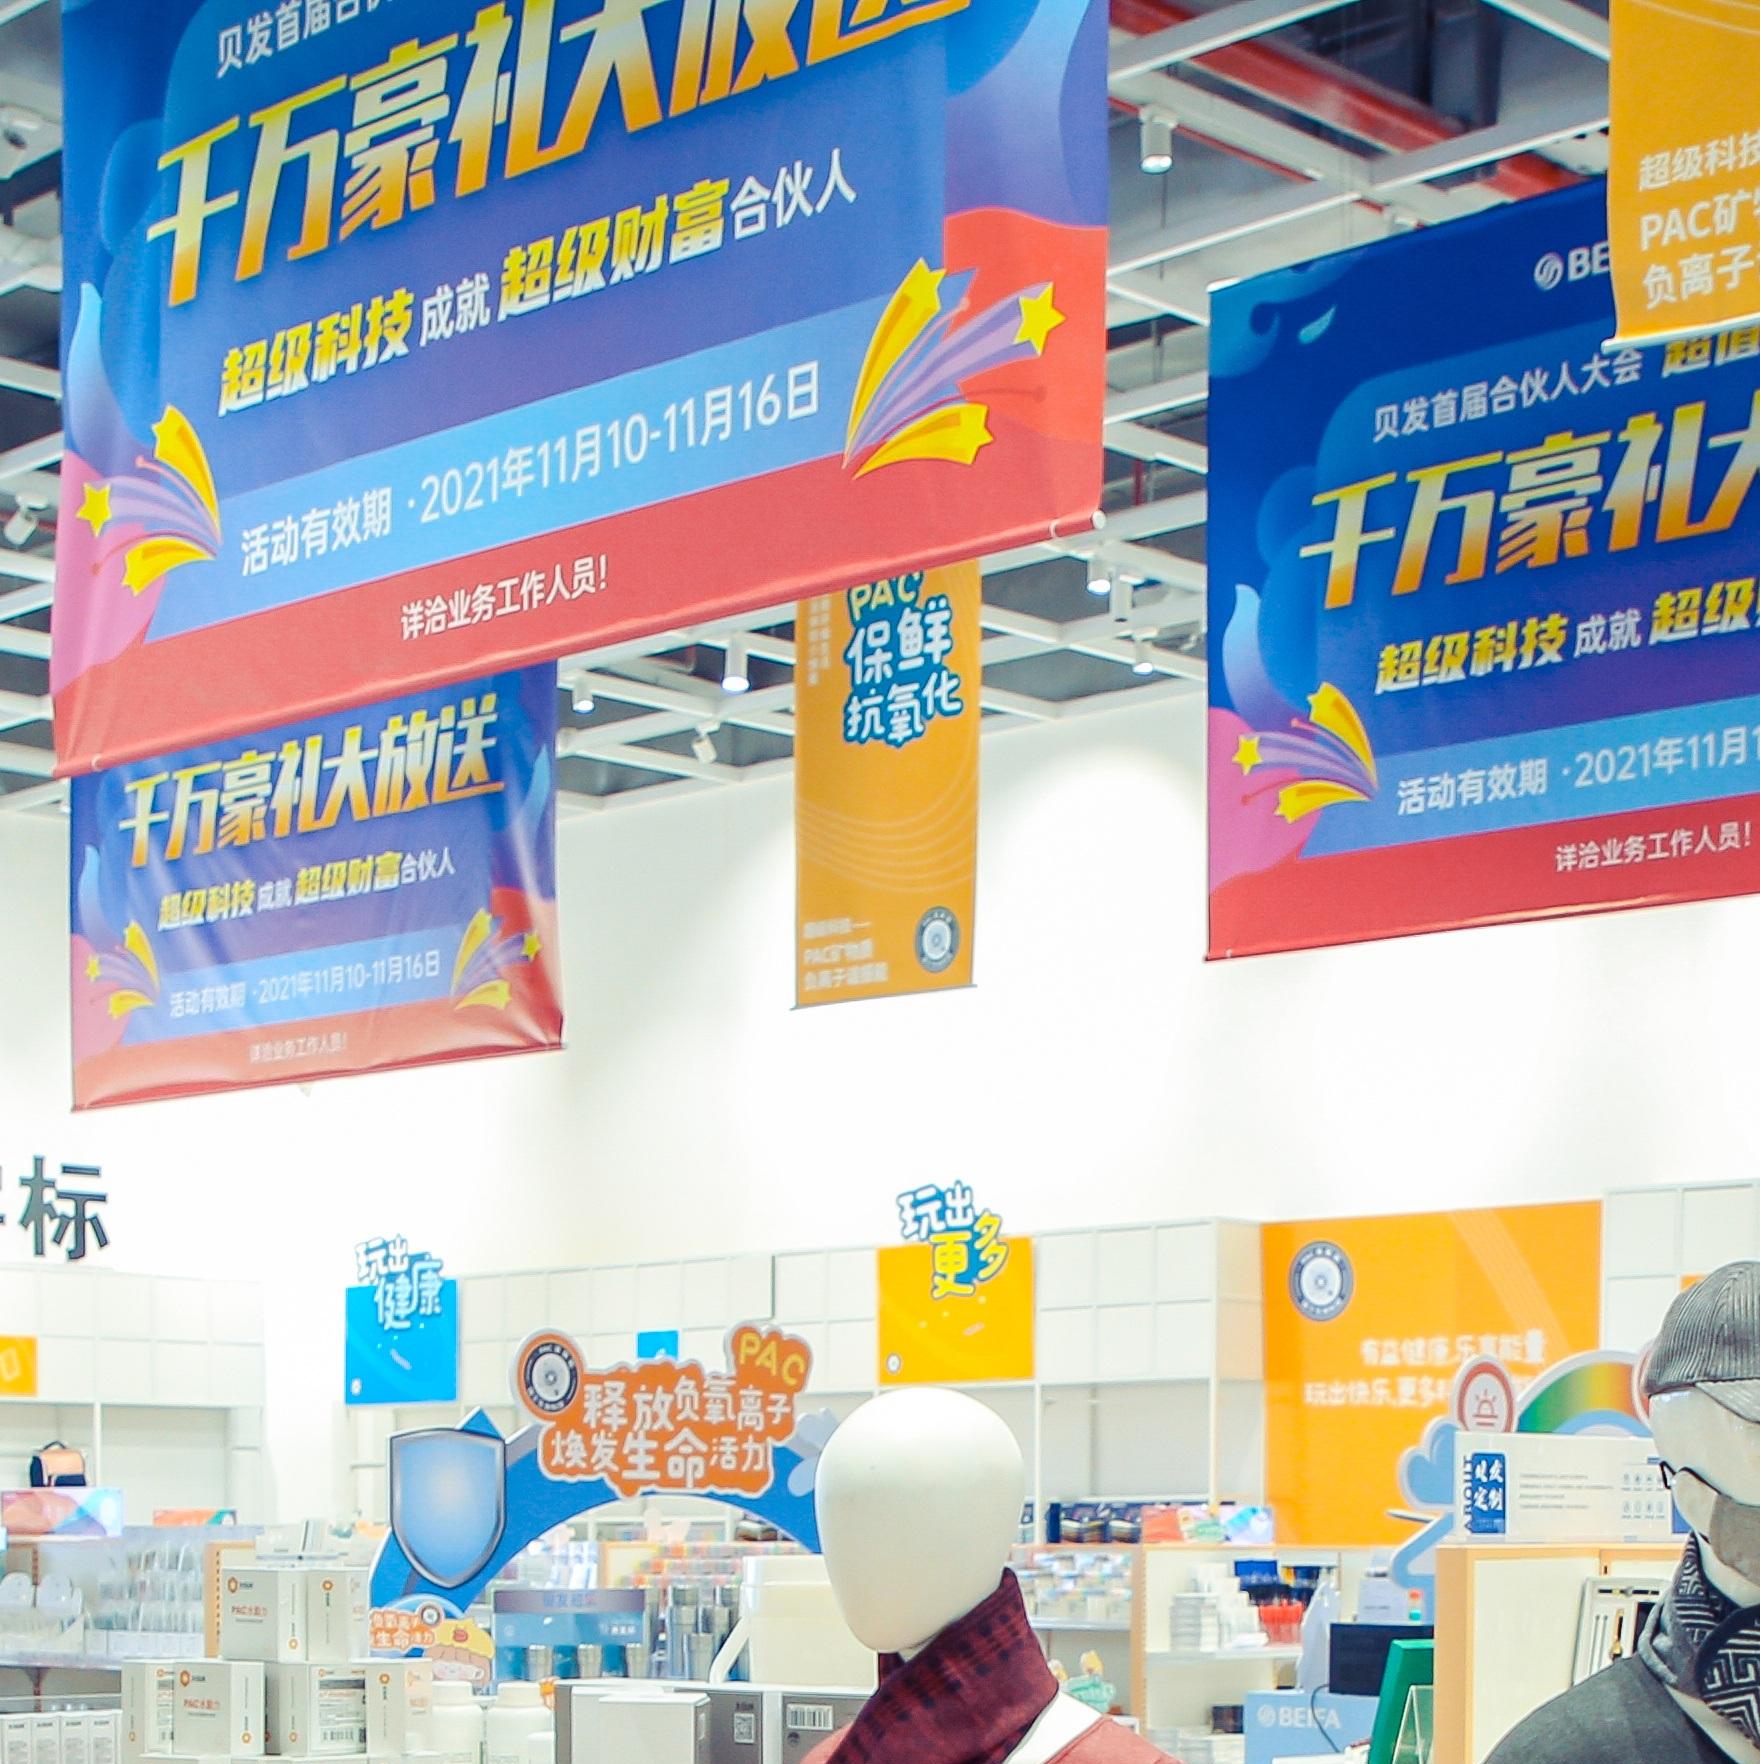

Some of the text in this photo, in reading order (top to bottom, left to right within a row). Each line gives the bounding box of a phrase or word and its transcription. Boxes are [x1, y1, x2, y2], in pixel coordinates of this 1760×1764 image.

[218, 148, 857, 419] 超级科技 成就 超级财富合伙人
[1372, 350, 1645, 446] 贝发首届合伙人大会
[240, 486, 394, 577] 活动有效期
[850, 573, 922, 621] PAC
[846, 599, 952, 687] 保鲜
[1375, 610, 1569, 697] 超级科技
[1573, 605, 1644, 661] 成就
[846, 668, 963, 745] 抗氧化
[119, 692, 505, 868] 千万豪礼大放送
[1397, 757, 1550, 818] 活动有效期
[157, 846, 457, 931] 超级科技 成就 超级财富合伙人
[169, 981, 246, 1018] 活动有效期
[898, 1180, 975, 1243] 玩出
[354, 1235, 410, 1287] 玩出
[929, 1207, 1012, 1300] 更多
[374, 1253, 445, 1332] 健康
[739, 1331, 805, 1387] PAC
[582, 1374, 791, 1432] 释放负氧离子
[550, 1427, 769, 1489] 焕发生命活力
[1279, 1706, 1341, 1730] BEIFA
